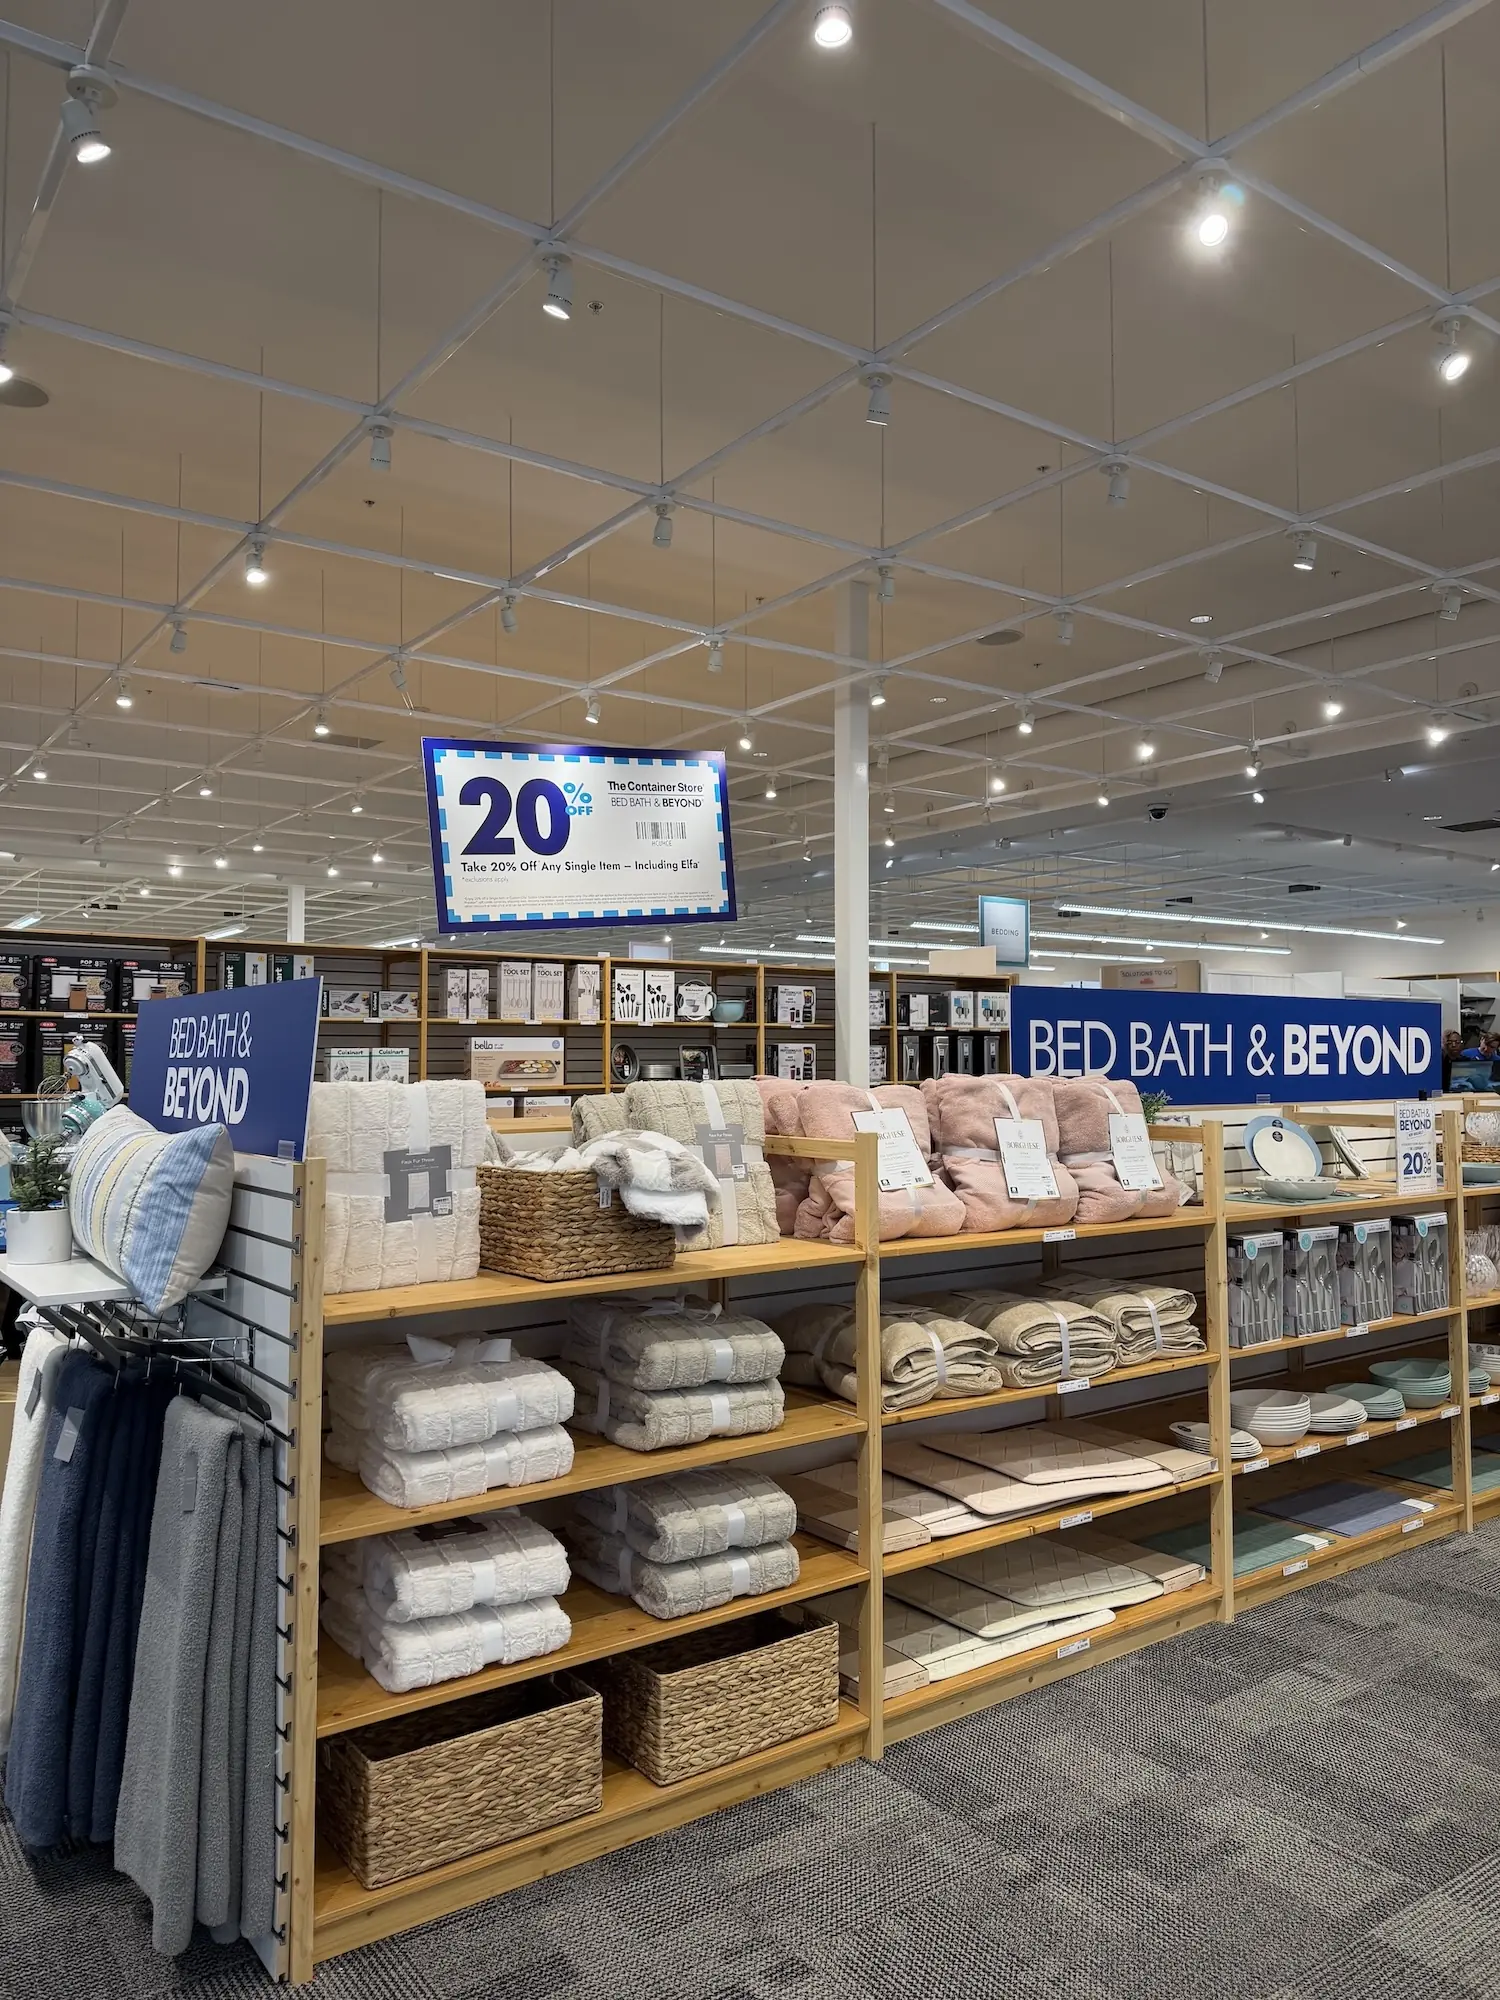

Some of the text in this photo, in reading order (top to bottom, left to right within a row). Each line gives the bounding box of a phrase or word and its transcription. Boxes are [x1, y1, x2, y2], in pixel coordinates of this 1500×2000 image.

[607, 781, 704, 793] The Container Store
[611, 797, 702, 808] BED BATH & BEYOND
[565, 805, 593, 815] OFF
[461, 861, 487, 872] Take
[490, 861, 517, 872] 20%
[541, 861, 561, 873] Any
[564, 860, 596, 873] Single
[600, 860, 620, 871] Item
[635, 860, 678, 872] Including
[681, 859, 699, 869] Elfa
[991, 927, 1019, 936] BEDDING
[1120, 970, 1153, 978] SOLUTIONS
[169, 1010, 253, 1058] BED BATH &
[474, 1040, 493, 1050] bella
[1029, 1019, 1432, 1077] BED BATH & BEYOND
[162, 1066, 249, 1125] BEYOND
[1399, 1108, 1430, 1119] BED BATH &
[1400, 1119, 1431, 1131] BEYOND
[1007, 1141, 1040, 1149] BORGHESE
